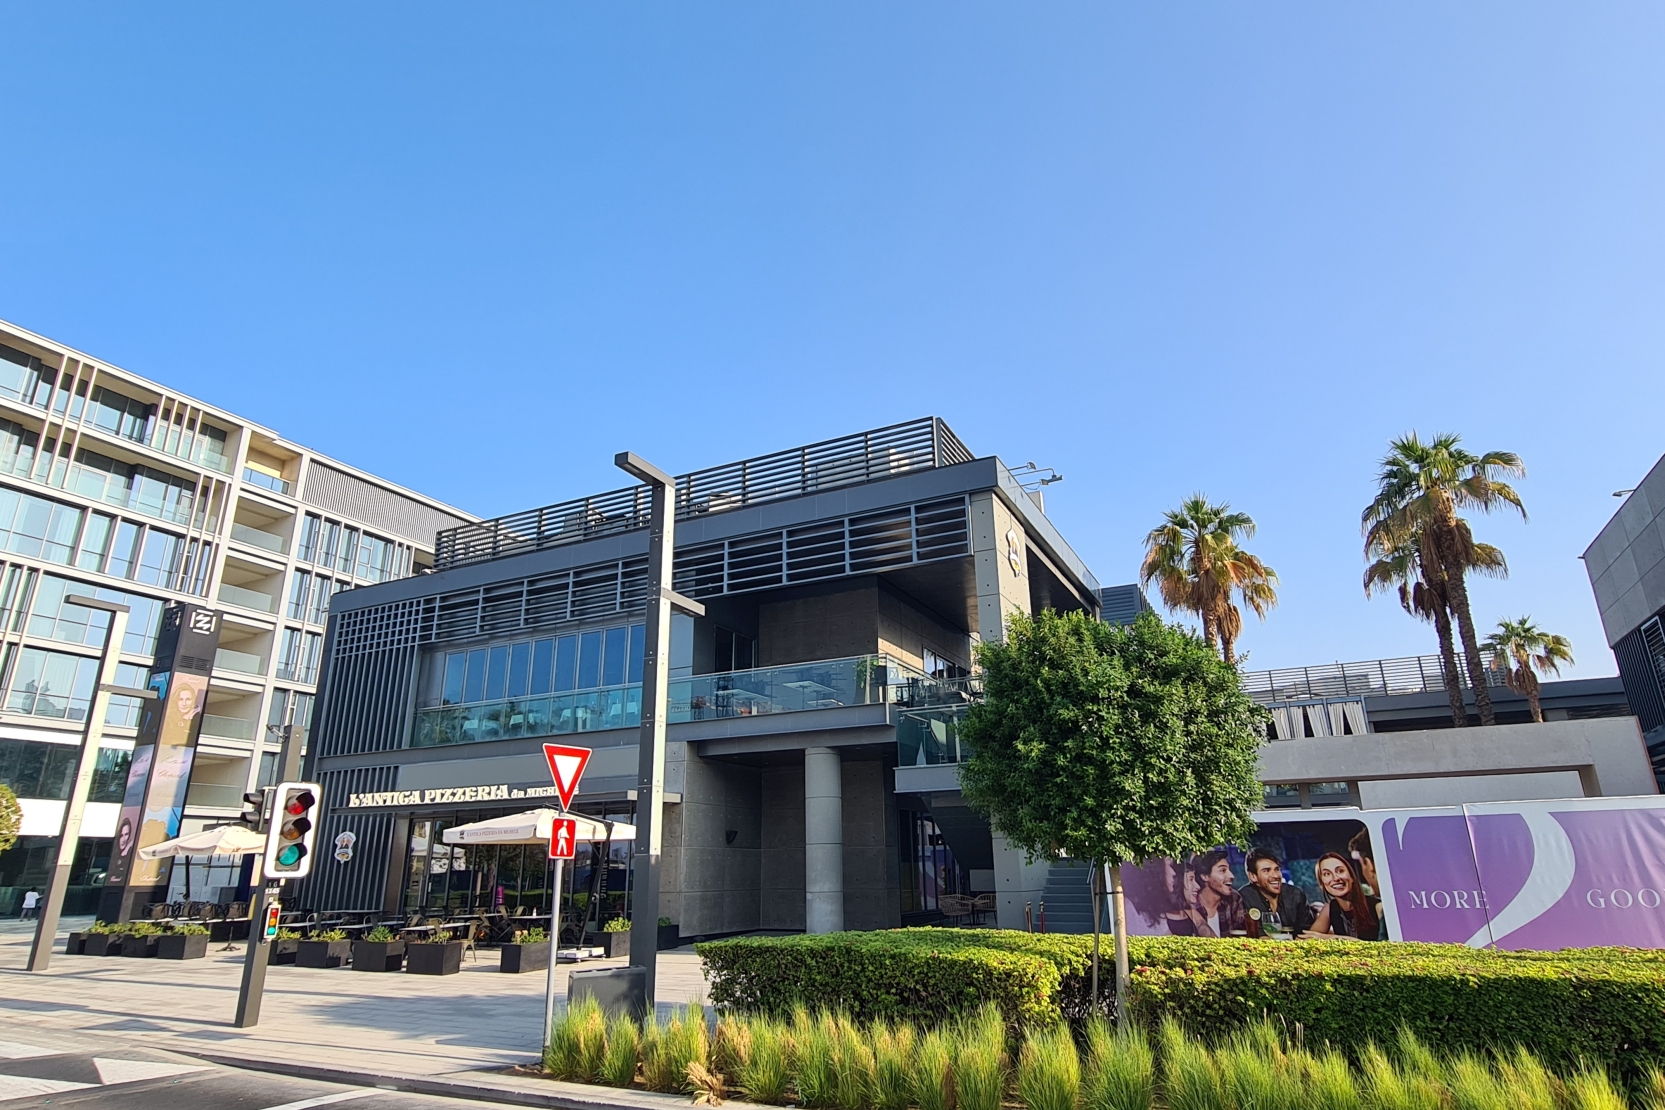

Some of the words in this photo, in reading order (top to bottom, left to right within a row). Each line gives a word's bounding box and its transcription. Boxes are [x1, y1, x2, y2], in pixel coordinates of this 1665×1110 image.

[423, 785, 510, 804] PIZZERIA
[511, 789, 525, 798] da
[1408, 890, 1490, 910] MORE
[1586, 888, 1665, 909] GOO
